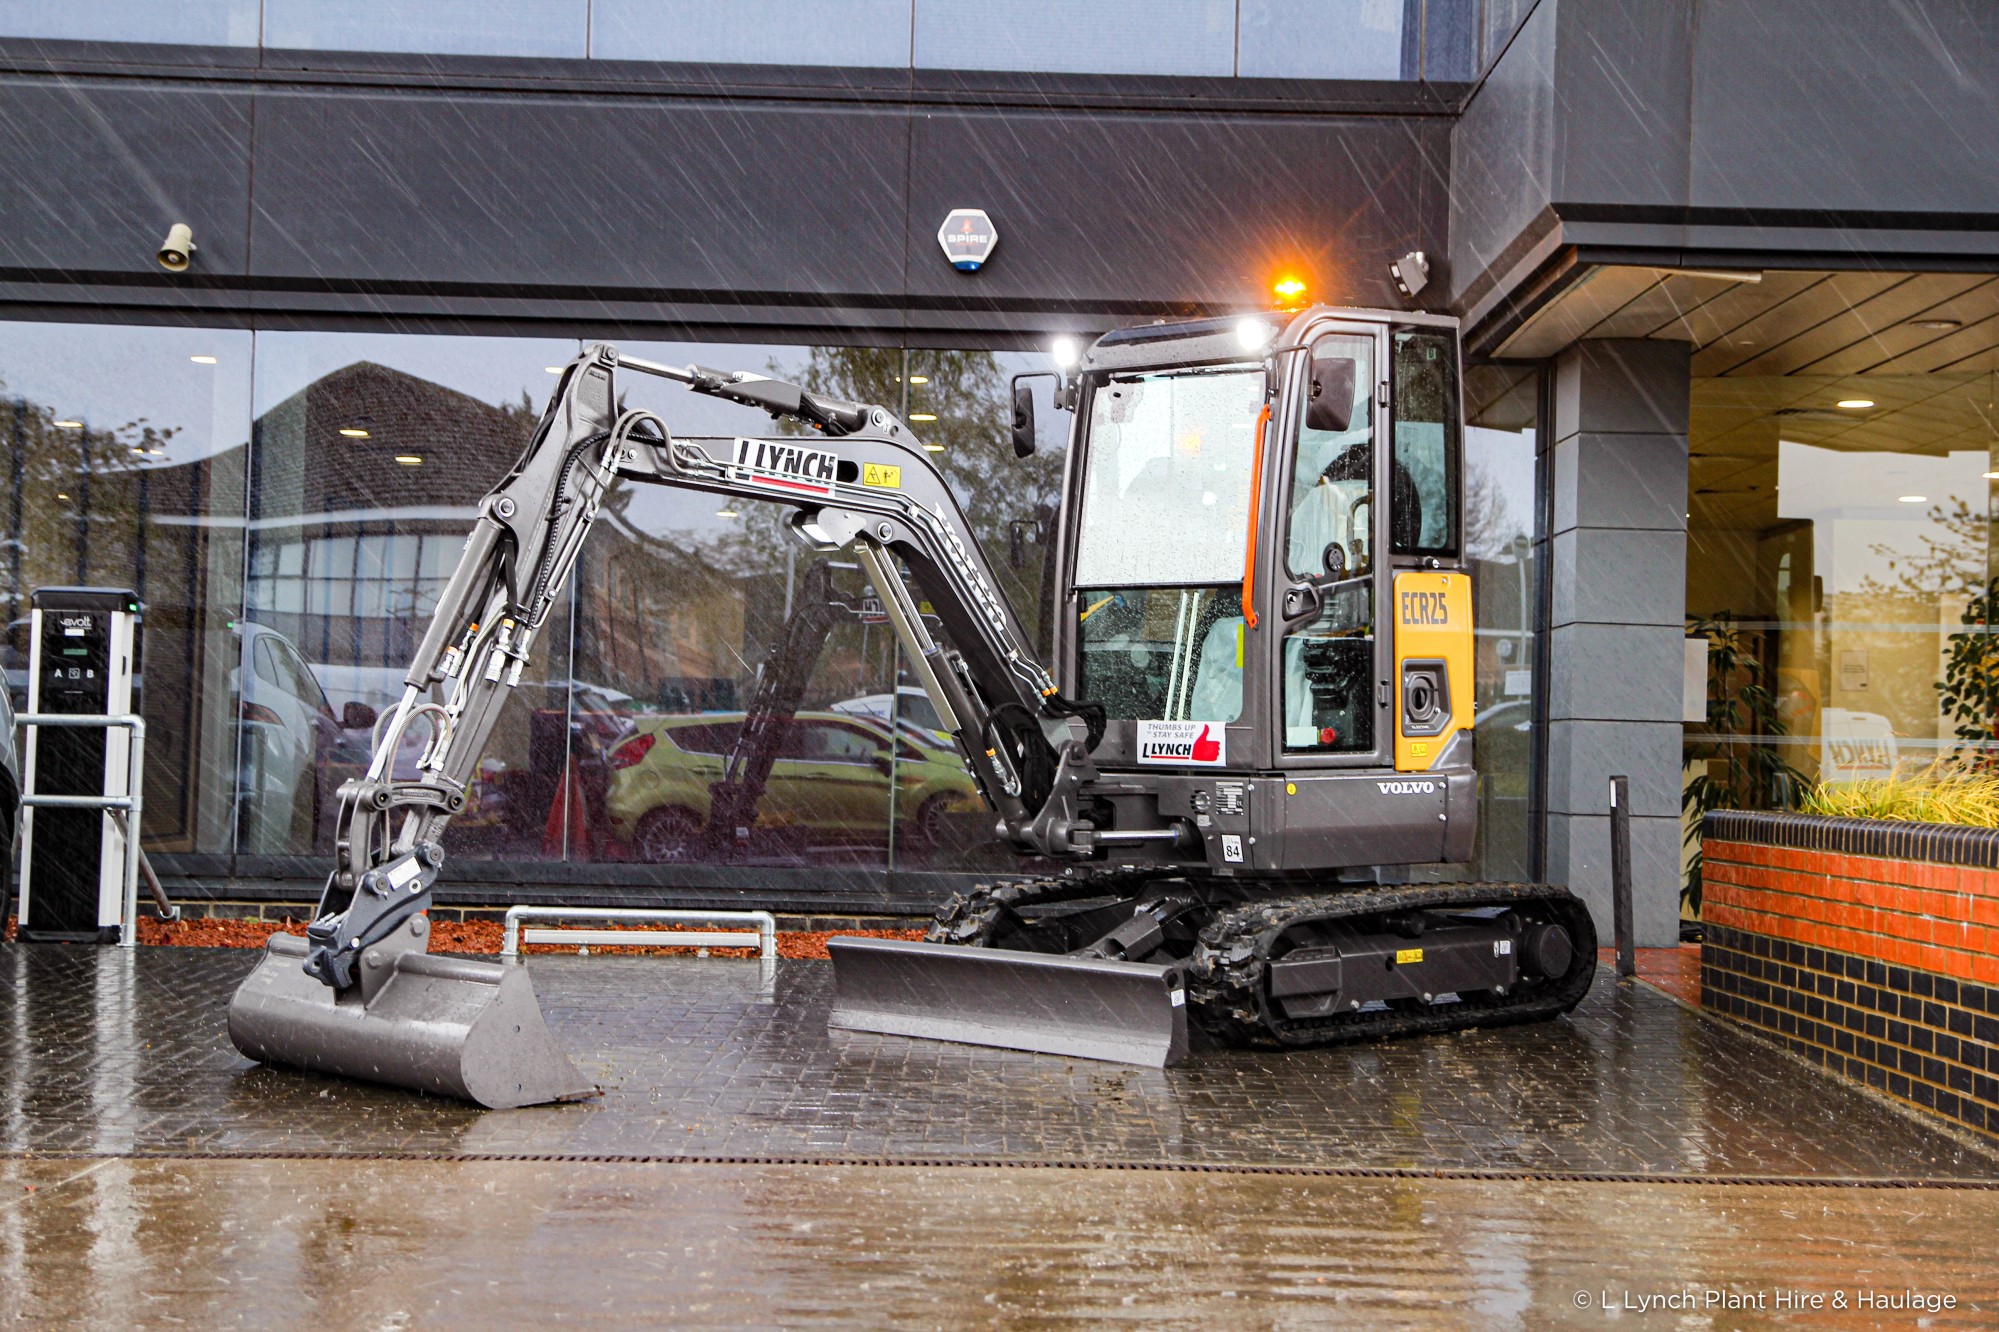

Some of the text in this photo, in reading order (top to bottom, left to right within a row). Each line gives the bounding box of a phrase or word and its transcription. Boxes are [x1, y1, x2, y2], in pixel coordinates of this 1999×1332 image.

[947, 232, 988, 244] SPIRE
[754, 443, 836, 484] LYNCH
[932, 501, 1007, 632] VOLVO
[1401, 591, 1448, 625] ECR25
[54, 668, 63, 678] A
[86, 669, 95, 679] B
[1148, 723, 1182, 731] THUMBS
[1153, 731, 1172, 739] STAY
[1174, 731, 1195, 739] SAFE
[1142, 743, 1192, 758] L LYNCH
[1376, 781, 1435, 795] VOLVO
[1226, 845, 1240, 857] 84
